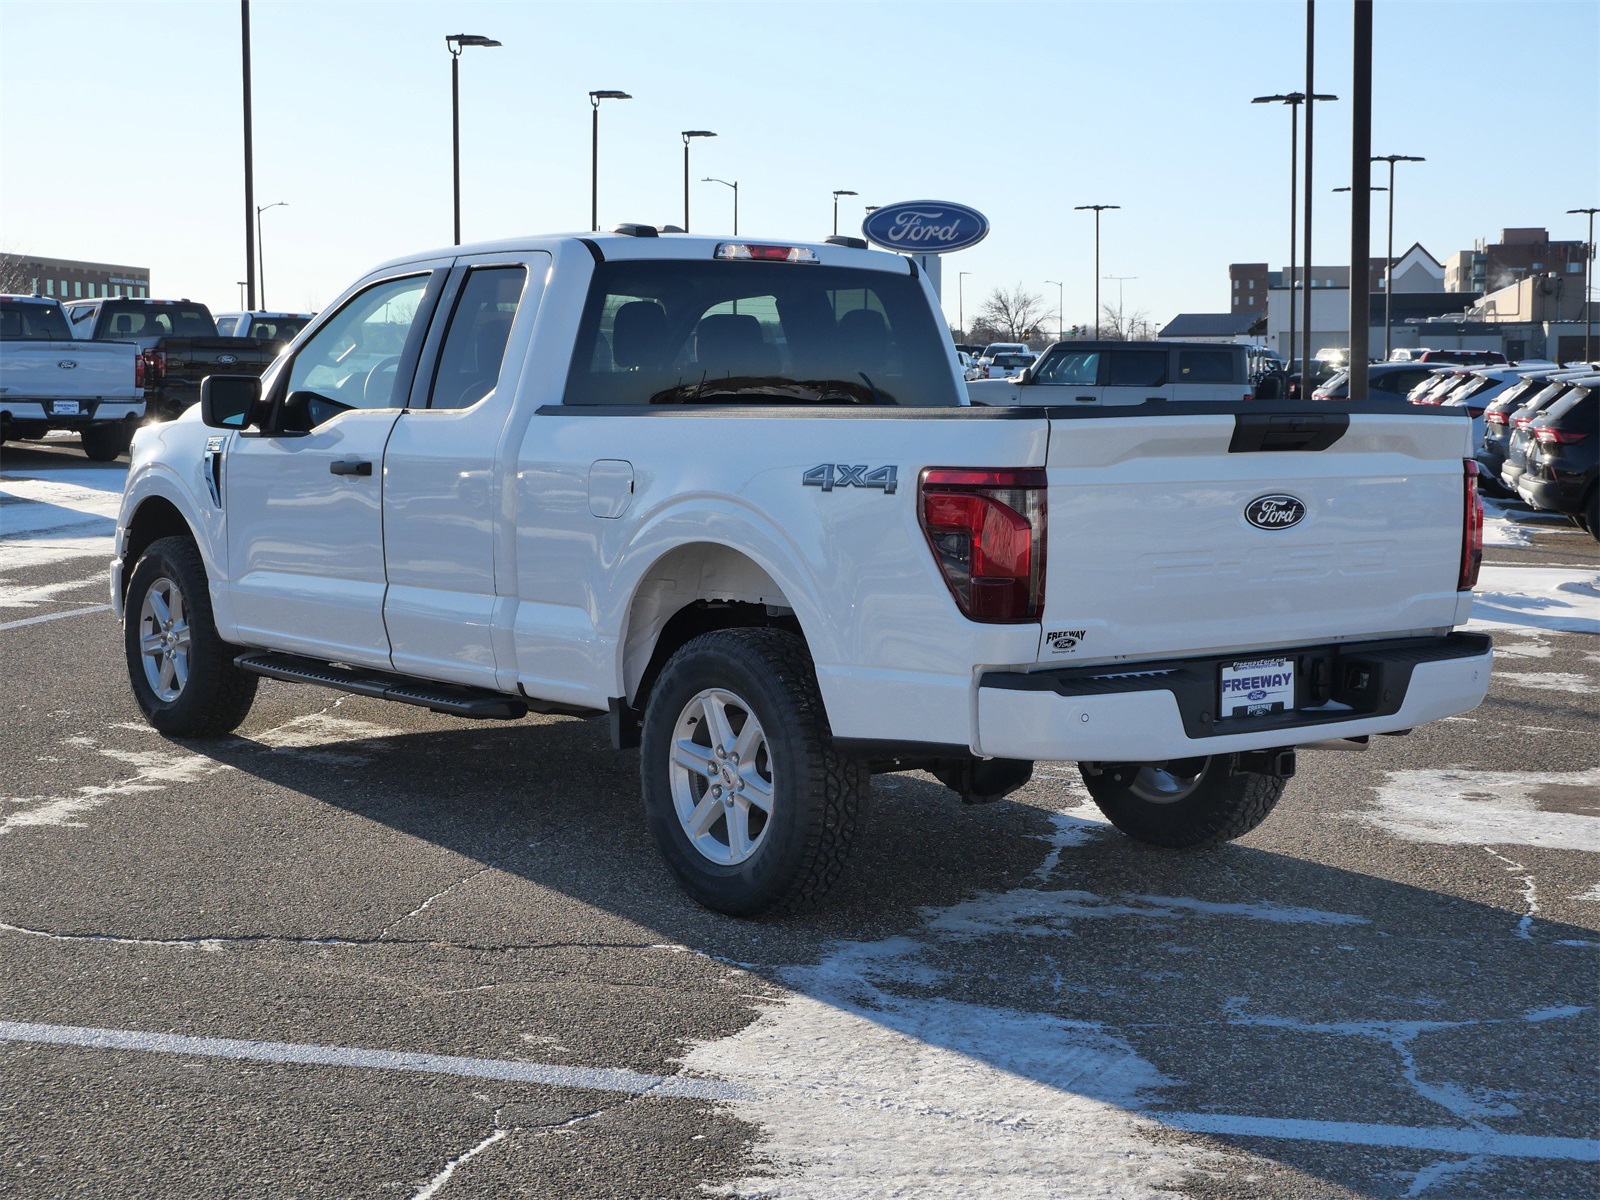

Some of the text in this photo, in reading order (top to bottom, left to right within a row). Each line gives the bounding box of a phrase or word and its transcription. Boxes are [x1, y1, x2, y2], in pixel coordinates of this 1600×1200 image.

[888, 211, 960, 241] Ford
[1257, 500, 1296, 523] Ford
[1046, 630, 1086, 645] FREEWAY
[1222, 673, 1292, 692] FREEWAY
[1247, 703, 1273, 715] FREEWAY
